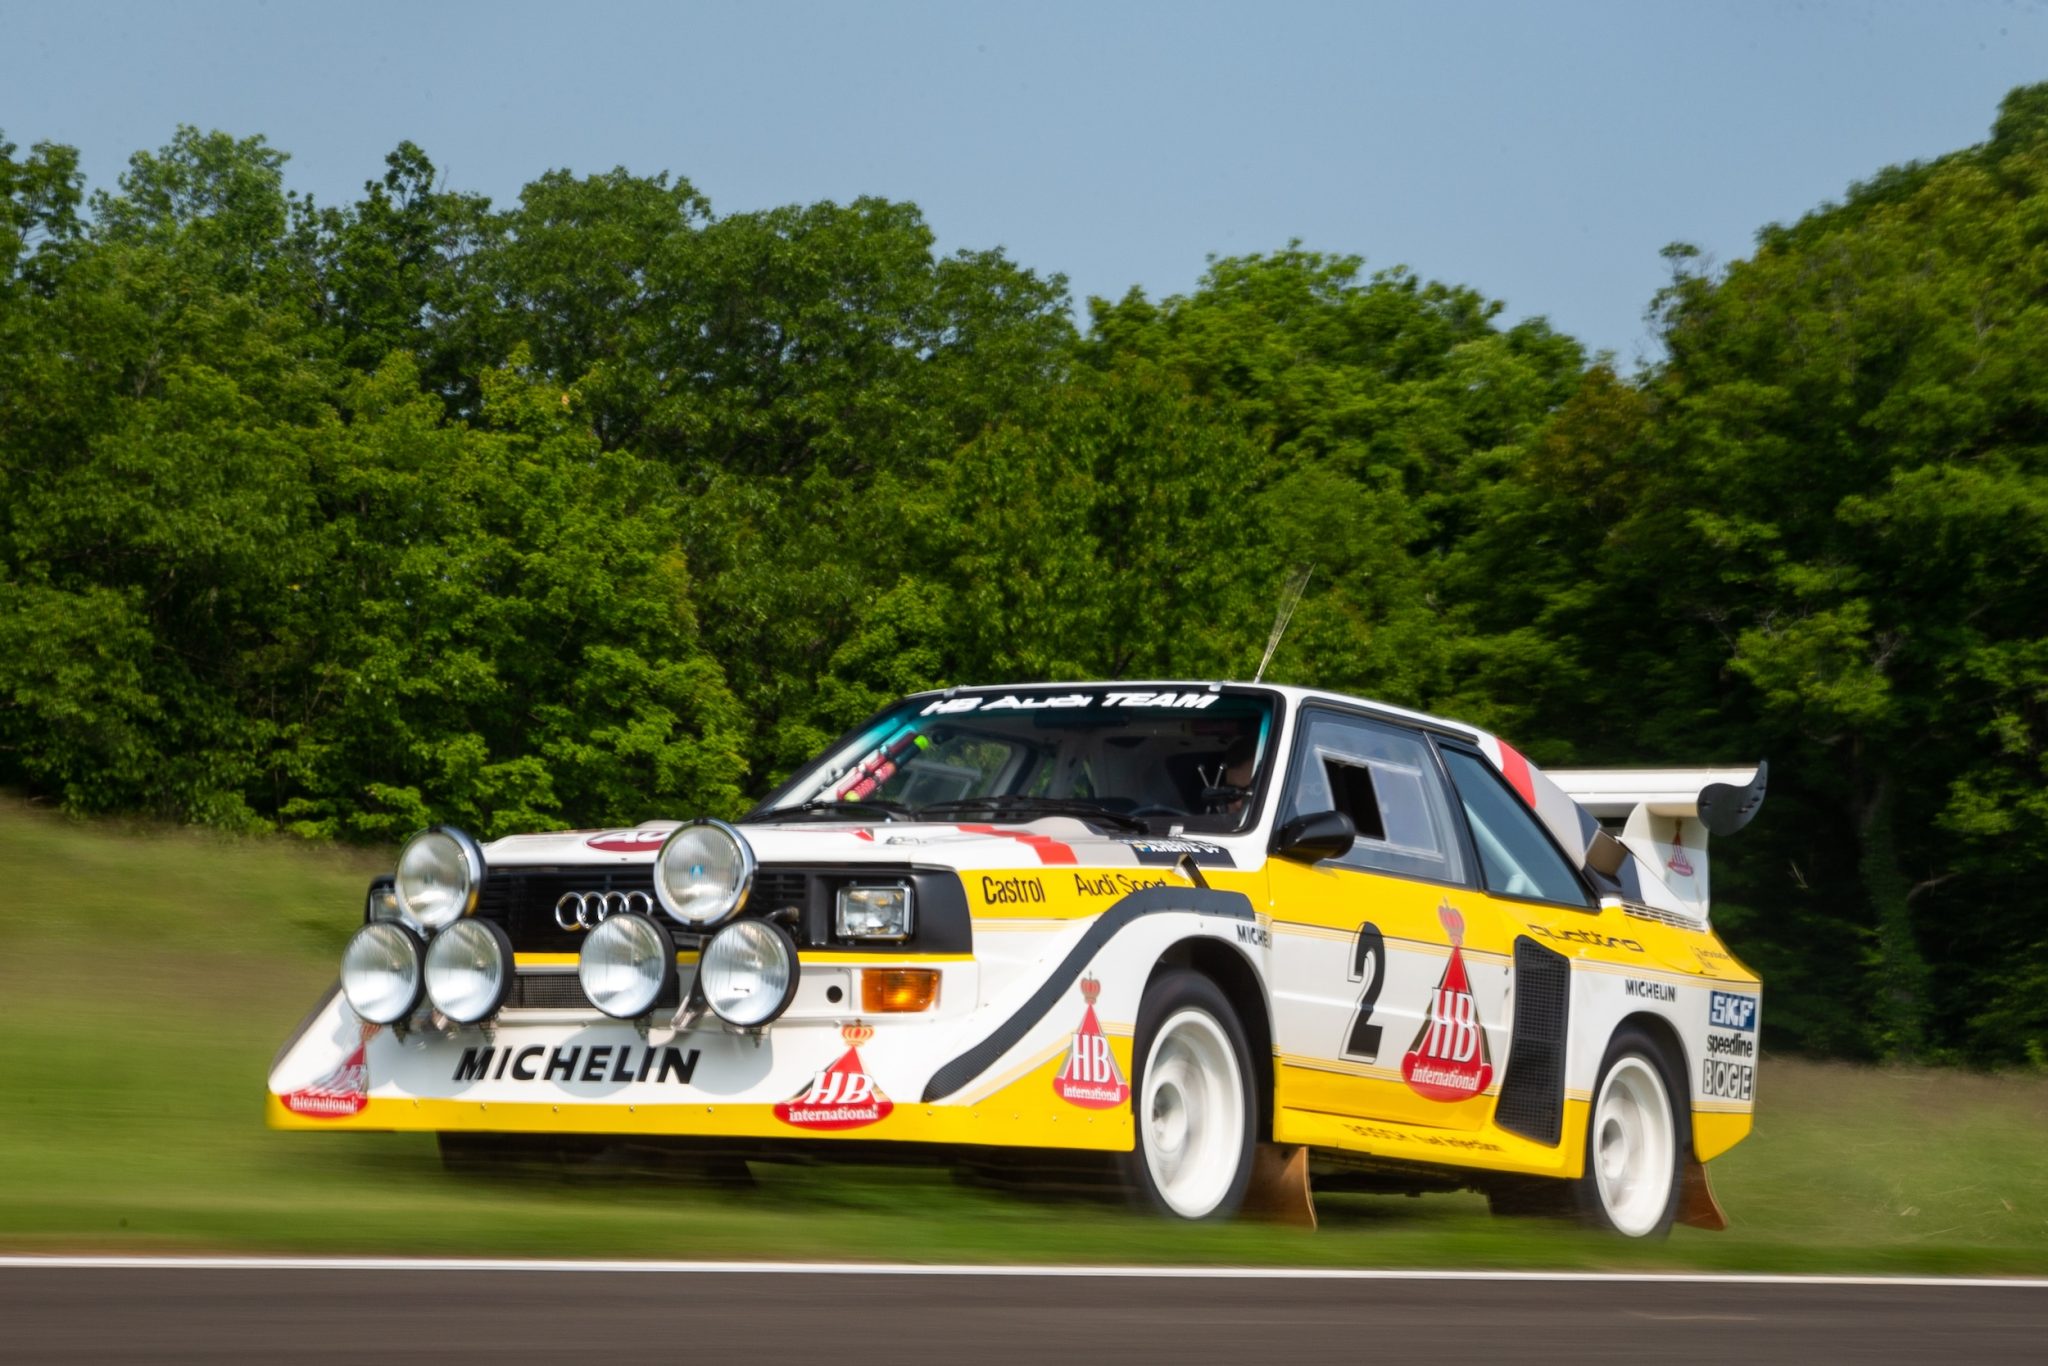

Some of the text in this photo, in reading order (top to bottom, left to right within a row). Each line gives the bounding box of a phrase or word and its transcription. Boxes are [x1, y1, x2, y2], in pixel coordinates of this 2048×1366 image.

[1101, 692, 1219, 708] TEAM
[982, 876, 1047, 904] Castrol
[1074, 873, 1118, 896] Audi
[1338, 921, 1385, 1064] 2
[1625, 979, 1676, 1002] MICHELIN
[1711, 995, 1754, 1027] SKF
[1427, 987, 1478, 1063] HB
[1071, 1033, 1111, 1083] HB
[1706, 1032, 1753, 1058] speedline
[452, 1044, 702, 1084] MICHELIN
[1410, 1064, 1480, 1091] international
[803, 1070, 875, 1105] HB
[1063, 1084, 1121, 1102] international
[1702, 1059, 1753, 1101] BOGE
[289, 1093, 358, 1113] international
[788, 1104, 879, 1122] international
